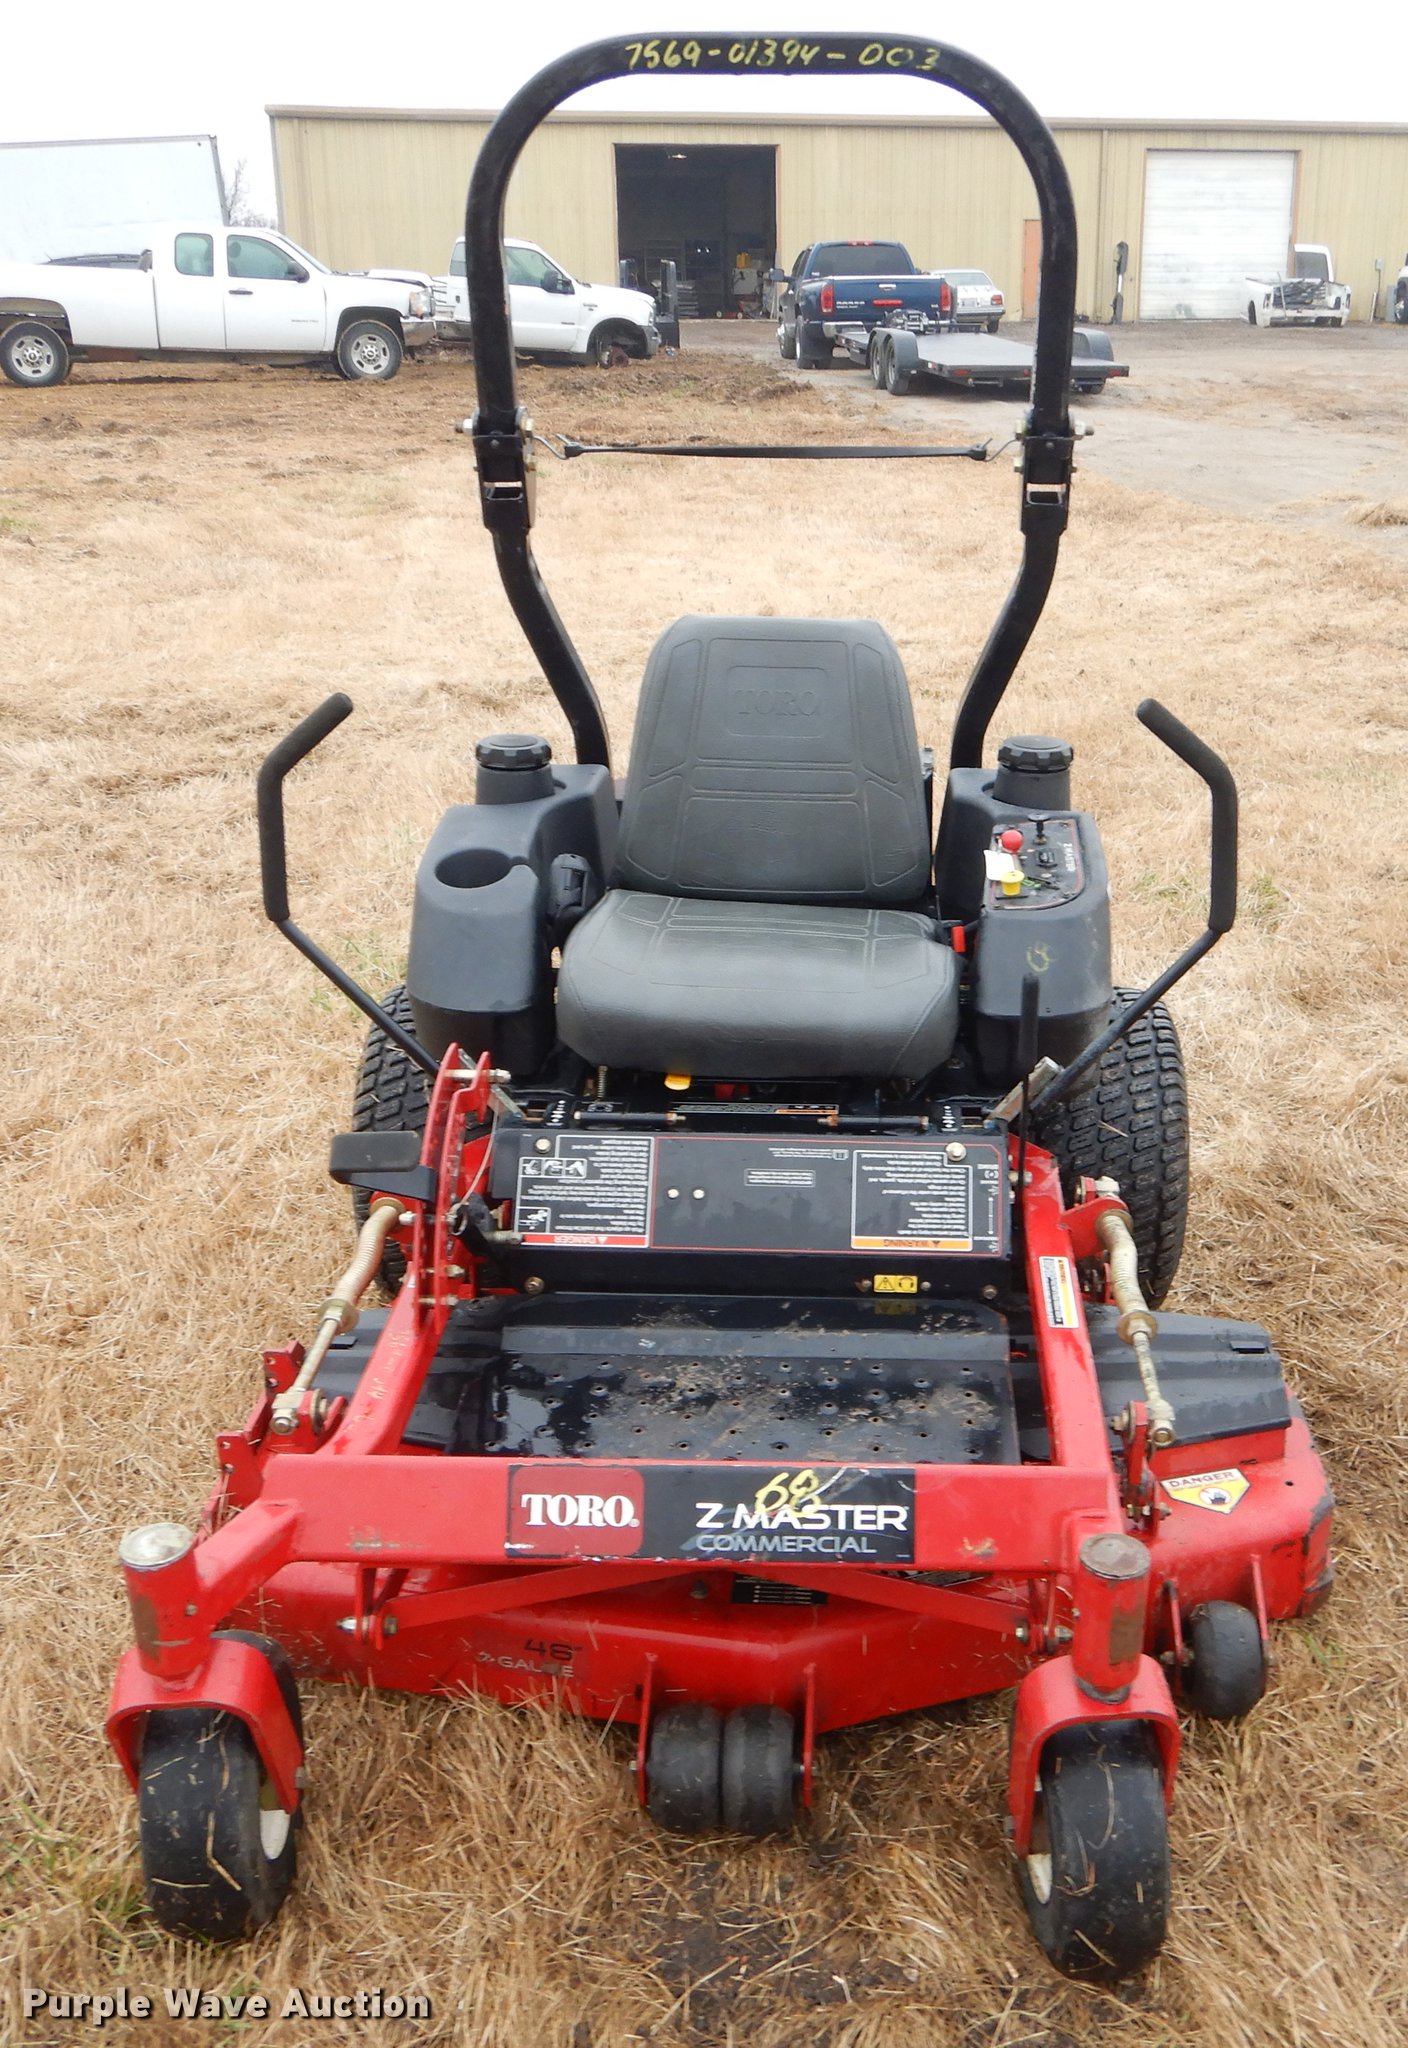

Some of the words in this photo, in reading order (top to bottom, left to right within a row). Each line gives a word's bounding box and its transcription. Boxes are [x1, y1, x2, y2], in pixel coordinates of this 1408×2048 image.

[1169, 1471, 1234, 1487] DANGER
[695, 1502, 724, 1529] Z
[732, 1502, 908, 1531] MASTER
[695, 1534, 877, 1553] COMMERCIAL
